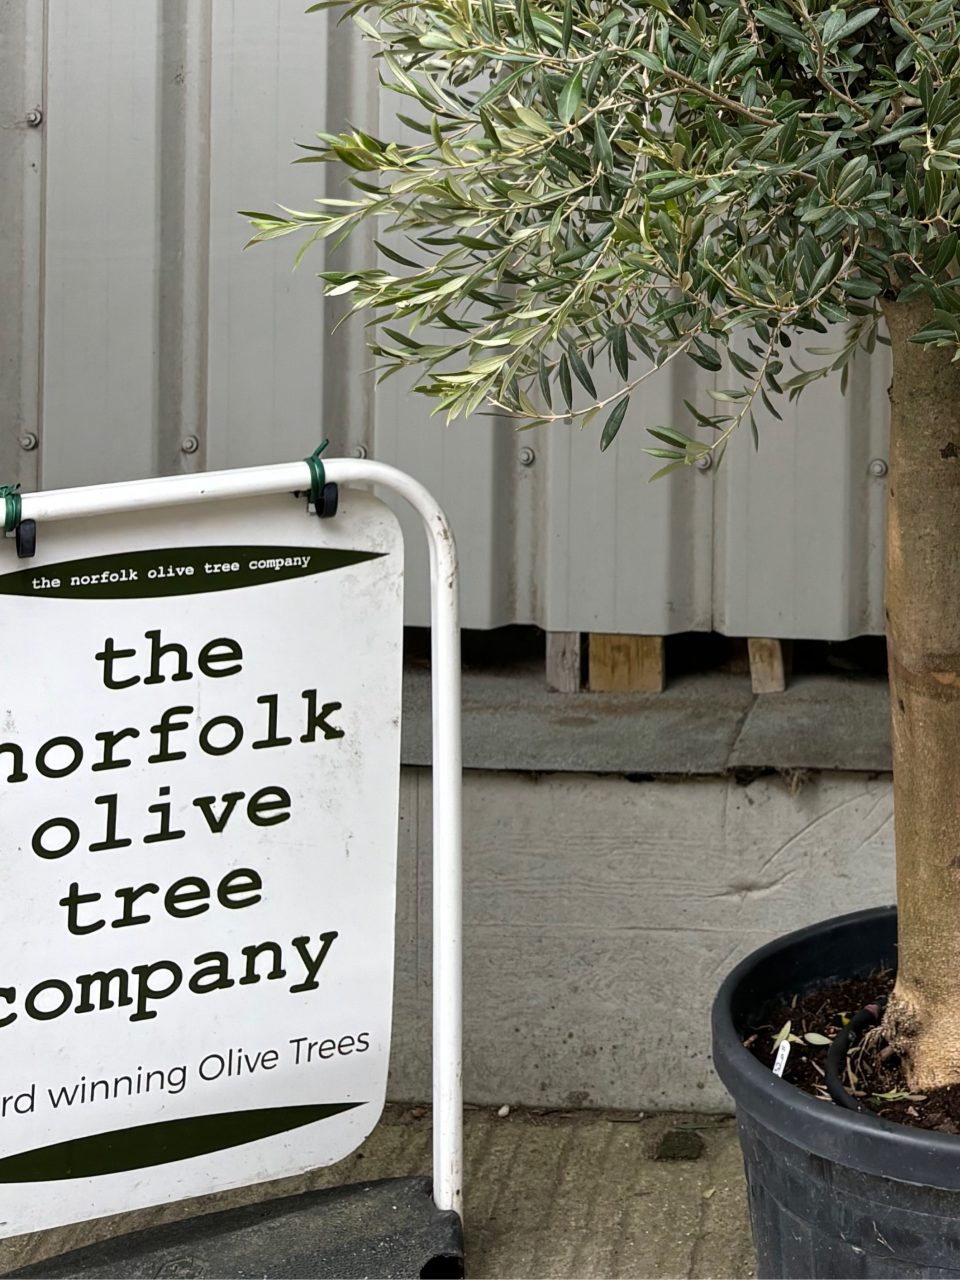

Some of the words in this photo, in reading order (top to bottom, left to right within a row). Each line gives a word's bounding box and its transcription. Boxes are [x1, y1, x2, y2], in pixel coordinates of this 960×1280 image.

[32, 577, 61, 590] the
[70, 568, 138, 586] norfolk
[147, 565, 195, 579] olive
[204, 561, 240, 574] tree
[249, 554, 311, 572] company
[95, 629, 243, 689] the
[31, 786, 291, 859] olive
[59, 868, 263, 935] tree
[48, 1065, 187, 1109] winning
[199, 1048, 279, 1082] Olive
[289, 1032, 370, 1067] Trees
